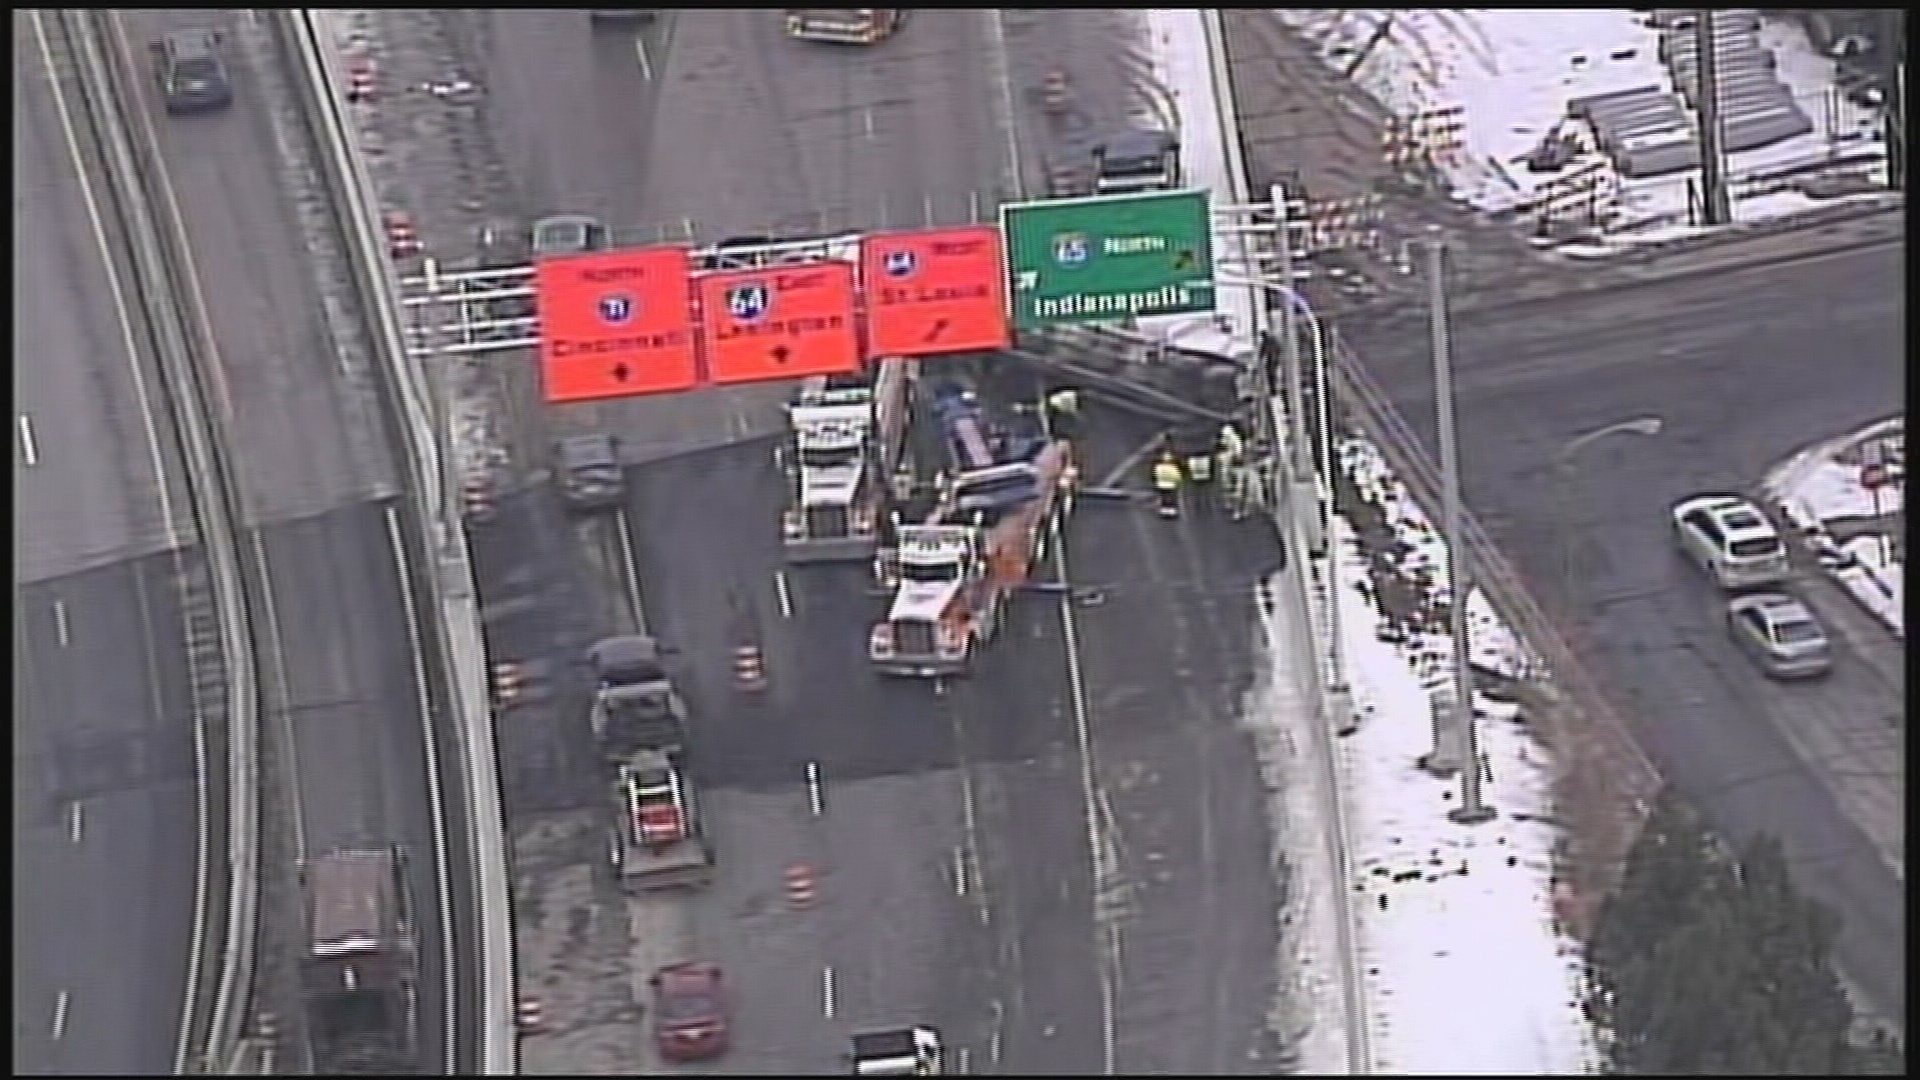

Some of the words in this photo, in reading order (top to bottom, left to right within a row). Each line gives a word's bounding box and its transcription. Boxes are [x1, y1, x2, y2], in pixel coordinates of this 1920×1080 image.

[1103, 236, 1166, 254] NORTH
[729, 287, 764, 316] 64
[1034, 284, 1192, 317] Indianapolis
